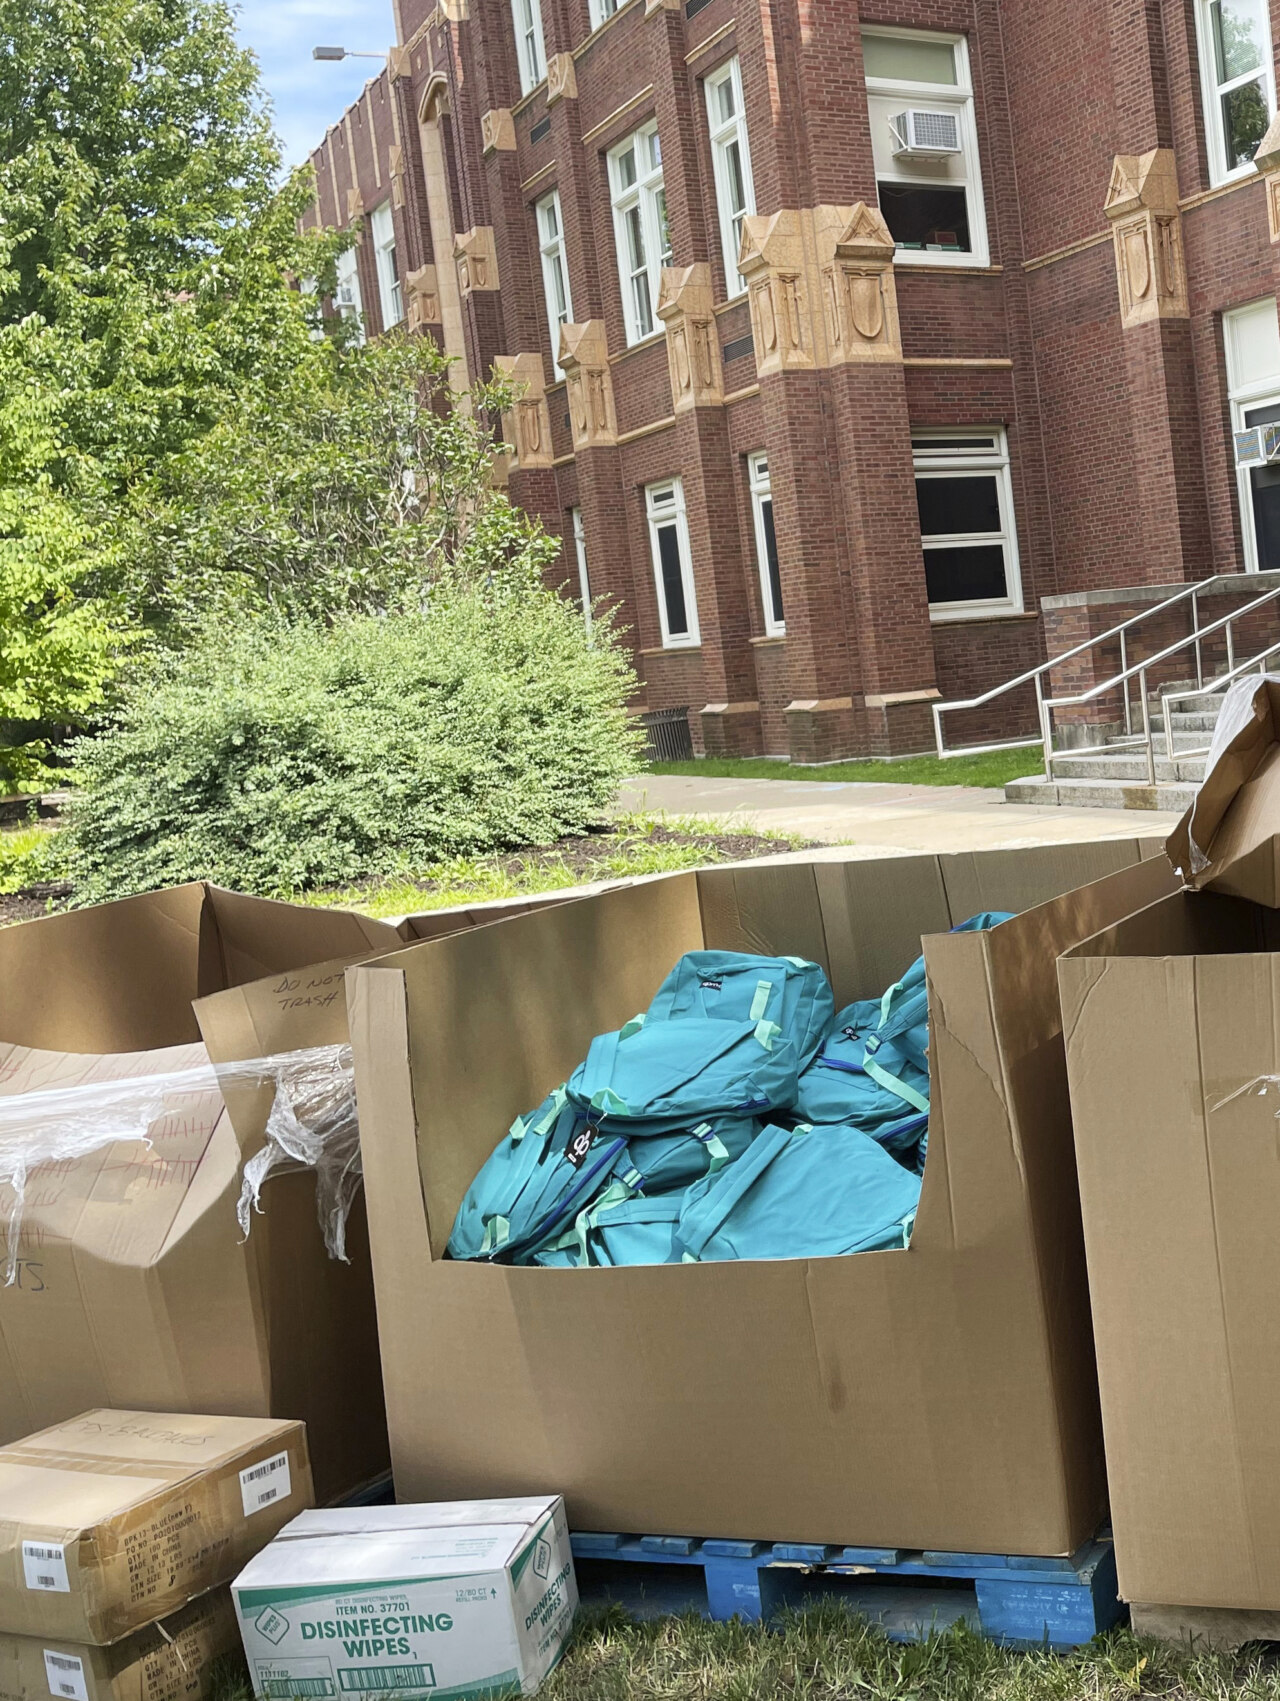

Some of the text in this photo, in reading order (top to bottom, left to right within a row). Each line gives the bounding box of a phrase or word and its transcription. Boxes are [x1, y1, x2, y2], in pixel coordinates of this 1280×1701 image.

[273, 973, 345, 993] DO NOT
[278, 991, 338, 1010] TRASH
[129, 1559, 147, 1573] MADE
[151, 1553, 159, 1562] IN
[477, 1587, 487, 1595] CT
[525, 1562, 571, 1631] DISINFECTING
[336, 1602, 410, 1616] ITEM NO. 37701
[539, 1593, 562, 1627] WIPES
[300, 1613, 454, 1640] DISINFECTING
[342, 1637, 411, 1658] WIPES
